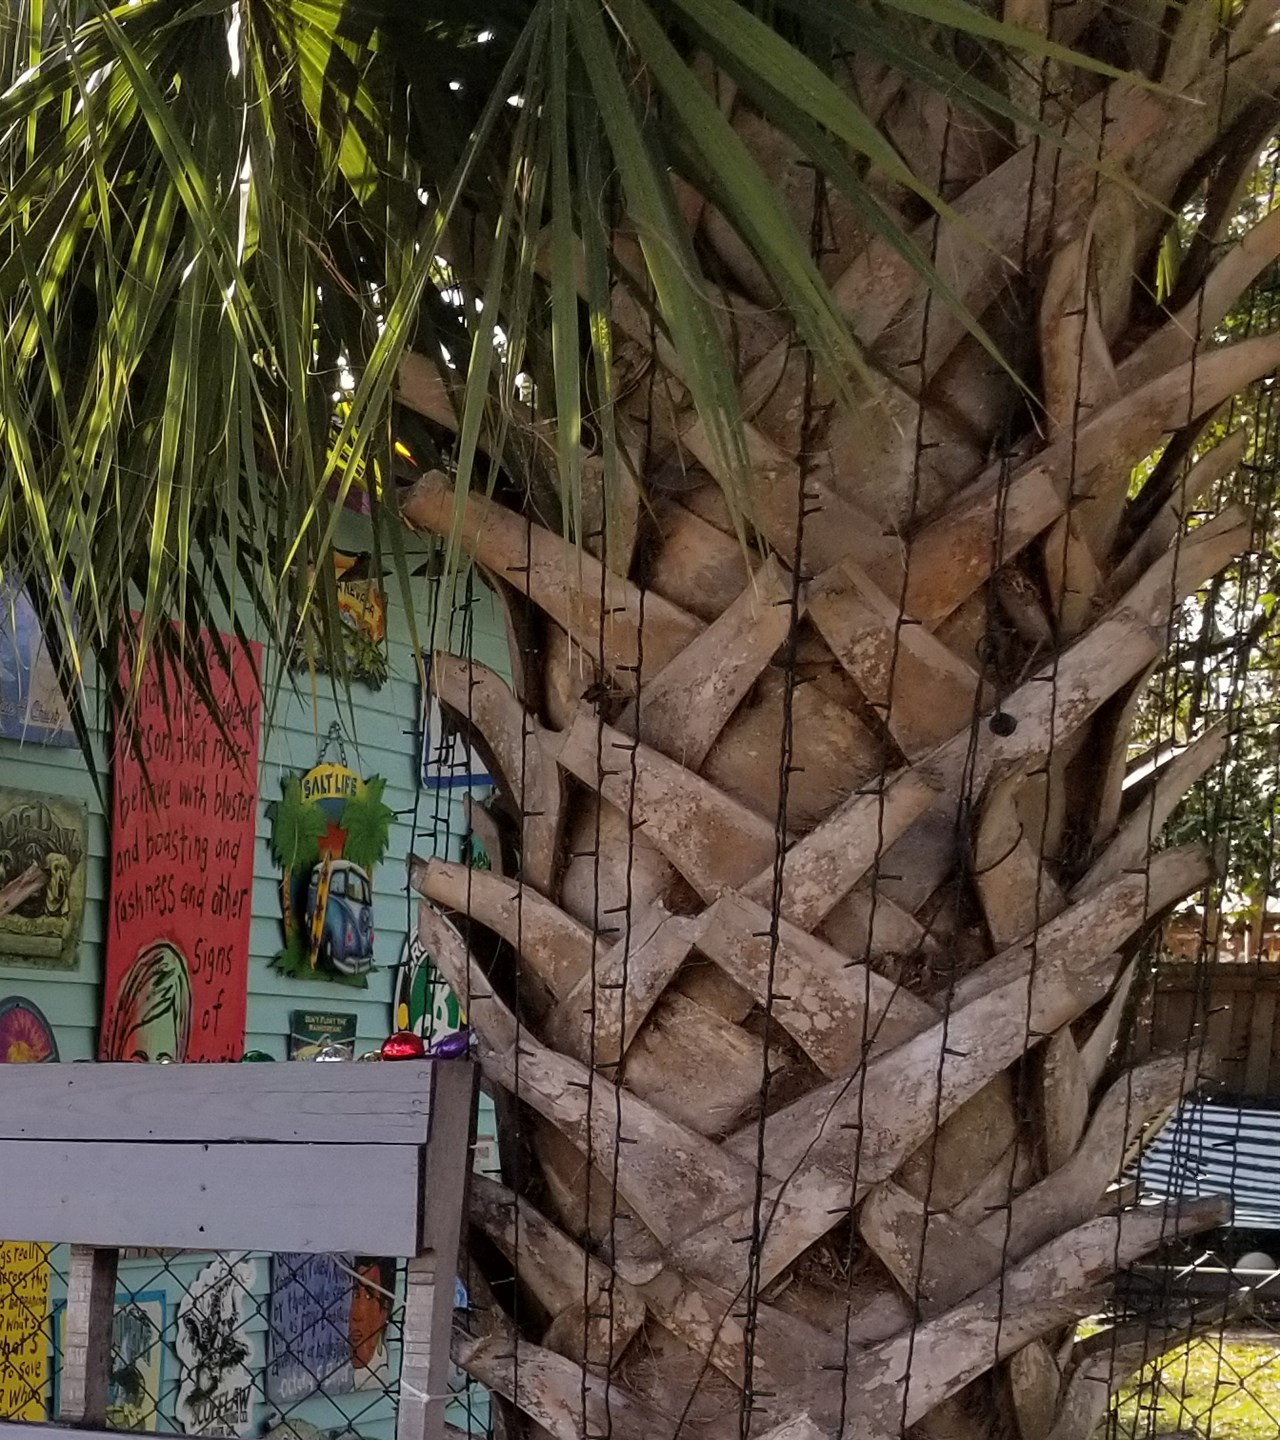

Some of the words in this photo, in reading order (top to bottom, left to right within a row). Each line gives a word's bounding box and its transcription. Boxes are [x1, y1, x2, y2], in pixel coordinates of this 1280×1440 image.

[179, 775, 207, 816] with
[213, 774, 255, 823] bluster
[303, 773, 334, 799] SALT
[335, 773, 358, 798] LIFE
[115, 826, 140, 878] and
[145, 819, 209, 873] boasting
[215, 831, 243, 869] and
[114, 873, 176, 938] rashness
[180, 876, 209, 918] and
[211, 872, 249, 923] other
[201, 987, 225, 1038] of
